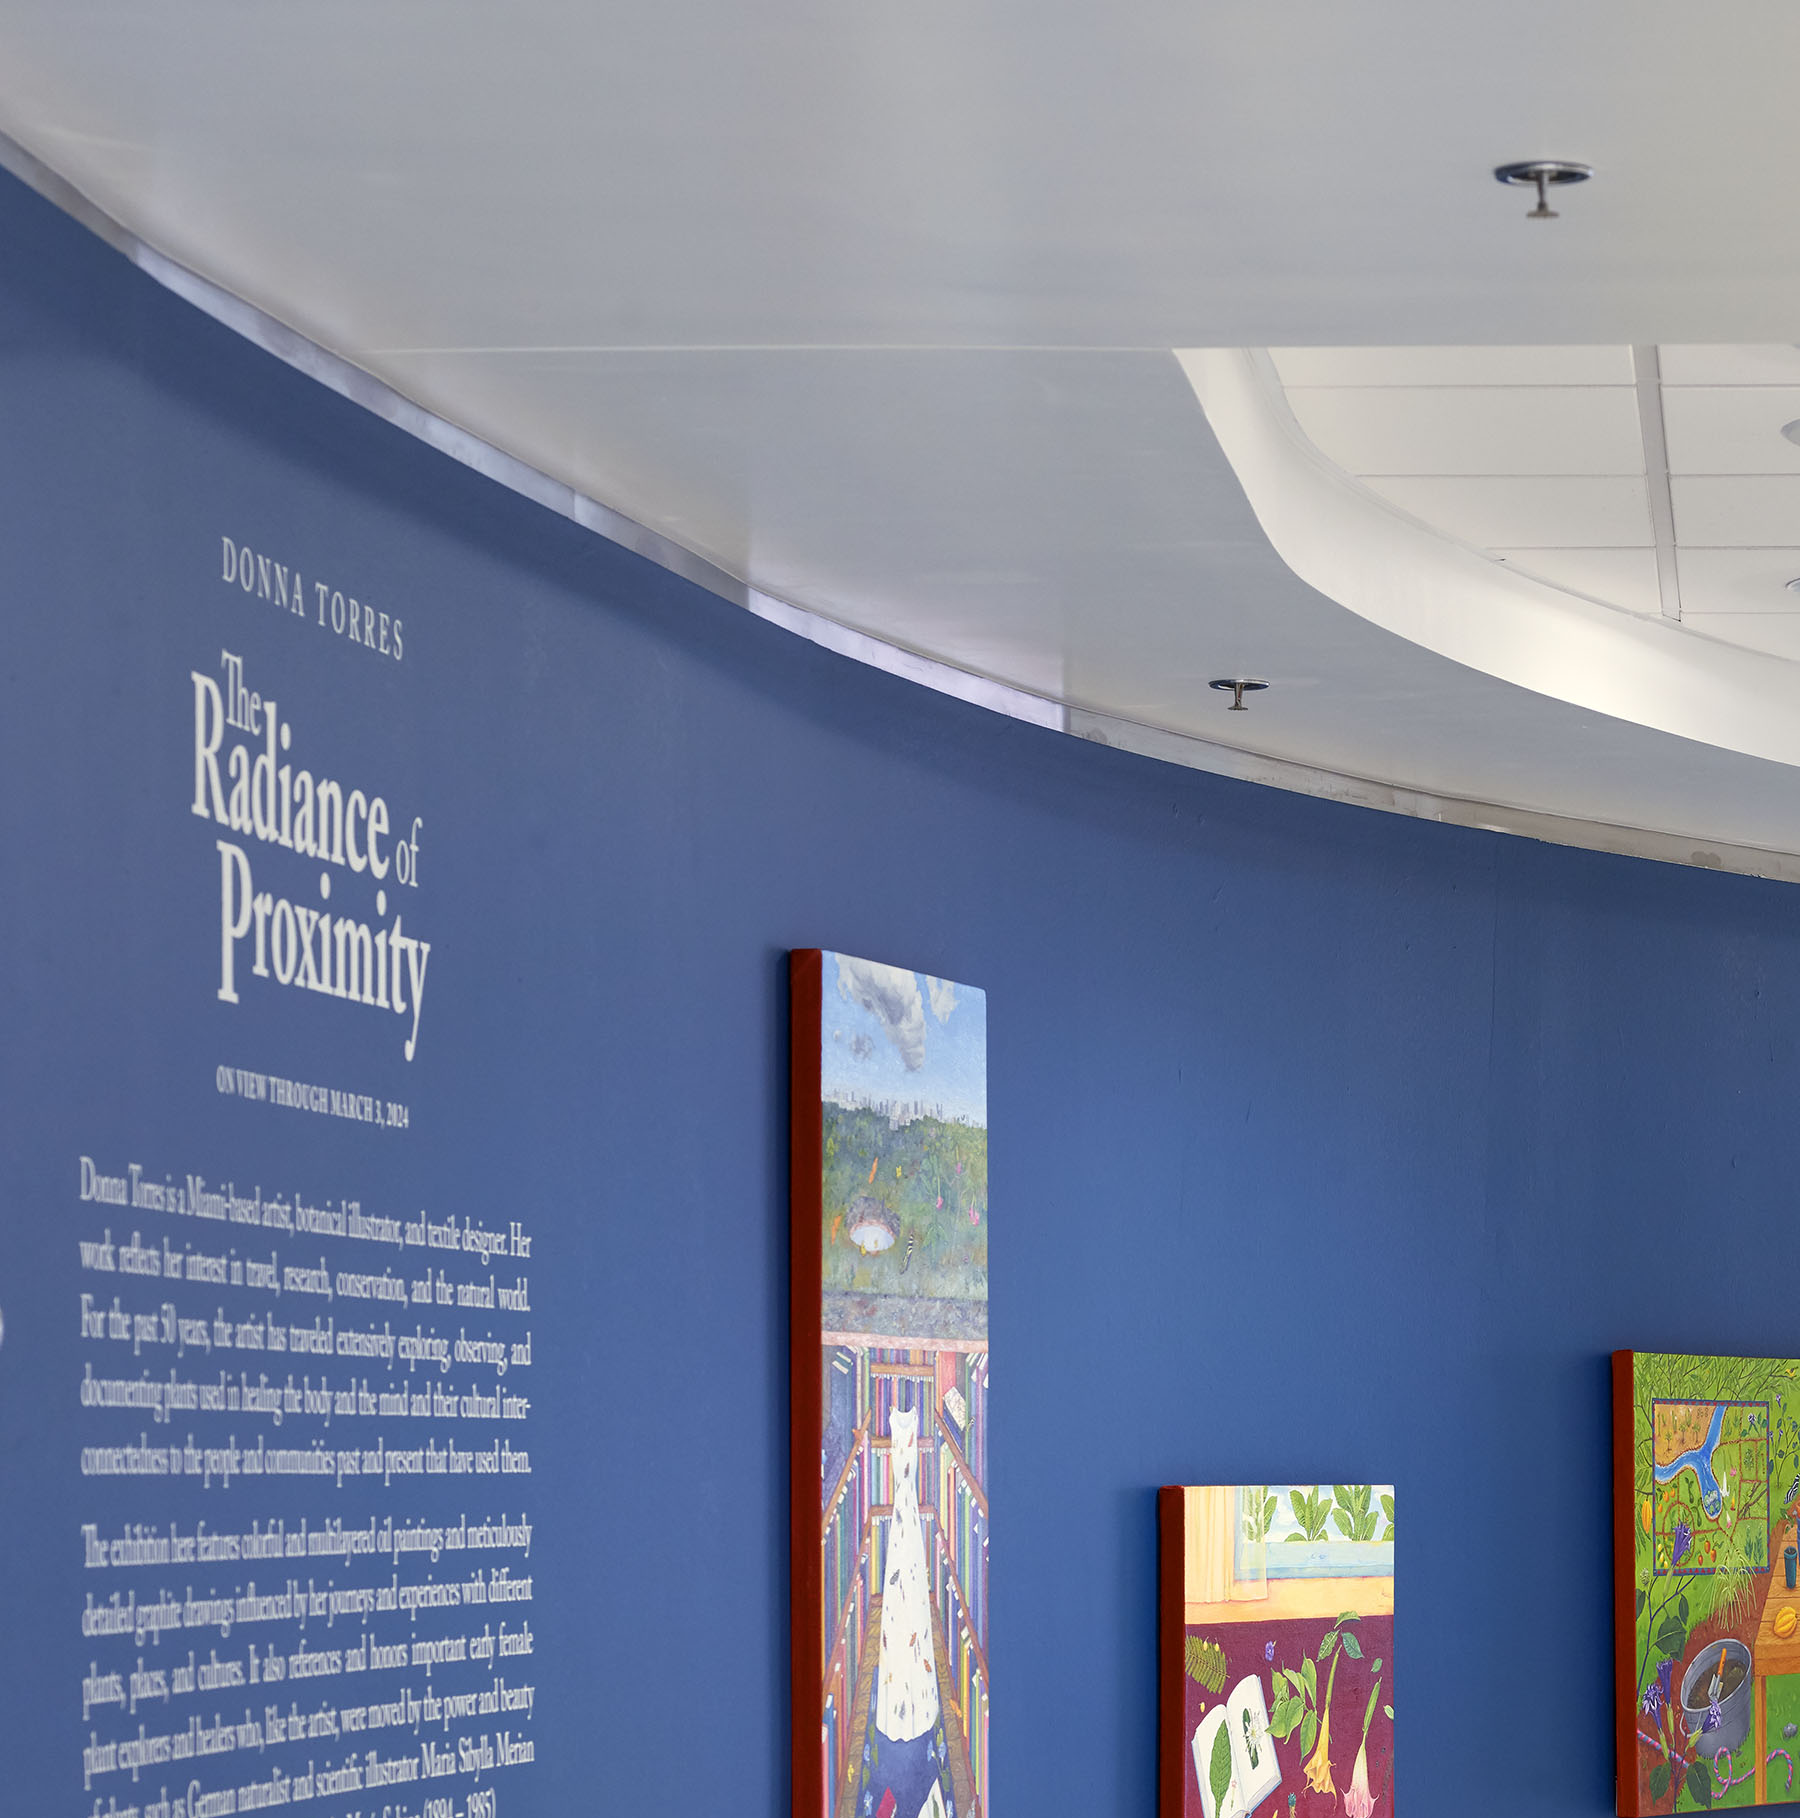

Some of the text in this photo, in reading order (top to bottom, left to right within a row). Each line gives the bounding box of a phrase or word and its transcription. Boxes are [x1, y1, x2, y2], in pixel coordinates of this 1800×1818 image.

[221, 536, 403, 661] DONNA TORRES
[221, 648, 263, 736] The
[191, 670, 423, 888] Radiance of
[216, 839, 431, 1062] Proximity
[216, 1065, 409, 1129] ON VIEW THROUGH MARCH 3, 2024
[348, 1201, 404, 1250] illustrator,
[404, 1210, 425, 1246] and
[427, 1215, 460, 1250] textile
[462, 1216, 507, 1265] designer.
[510, 1222, 531, 1258] Her
[336, 1267, 408, 1308] conservation,
[410, 1268, 432, 1303] and
[435, 1269, 453, 1305] the
[456, 1275, 494, 1308] natural
[497, 1277, 530, 1311] world.
[336, 1321, 396, 1370] extensively
[398, 1325, 451, 1373] exploring,
[454, 1328, 507, 1376] observing,
[510, 1332, 531, 1365] and
[334, 1378, 356, 1415] and
[358, 1379, 377, 1415] the
[378, 1380, 408, 1416] mind
[410, 1381, 431, 1417] and
[432, 1382, 458, 1417] their
[460, 1384, 500, 1418] cultural
[501, 1387, 530, 1419] inter-
[336, 1448, 360, 1488] past
[361, 1437, 383, 1474] and
[384, 1448, 424, 1486] present
[425, 1438, 448, 1473] that
[448, 1438, 473, 1473] have
[474, 1439, 499, 1473] used
[500, 1439, 532, 1473] them.
[376, 1516, 392, 1553] oil
[392, 1518, 443, 1565] paintings
[444, 1514, 465, 1550] and
[466, 1513, 532, 1558] meticulously
[326, 1580, 374, 1628] journeys
[375, 1573, 397, 1611] and
[398, 1574, 460, 1621] experiences
[461, 1569, 486, 1604] with
[488, 1567, 532, 1603] different
[344, 1634, 366, 1672] and
[369, 1633, 408, 1669] honors
[411, 1633, 466, 1676] important
[469, 1624, 496, 1670] early
[498, 1621, 533, 1656] female
[340, 1707, 366, 1732] were
[367, 1688, 405, 1728] moved
[406, 1688, 422, 1735] by
[422, 1686, 442, 1721] the
[442, 1693, 477, 1732] power
[478, 1678, 498, 1714] and
[499, 1678, 534, 1720] beauty
[315, 1753, 364, 1797] scientific
[364, 1750, 418, 1788] illustrator
[420, 1742, 456, 1779] Maria
[458, 1735, 494, 1782] Sibylla
[495, 1731, 534, 1767] Merian
